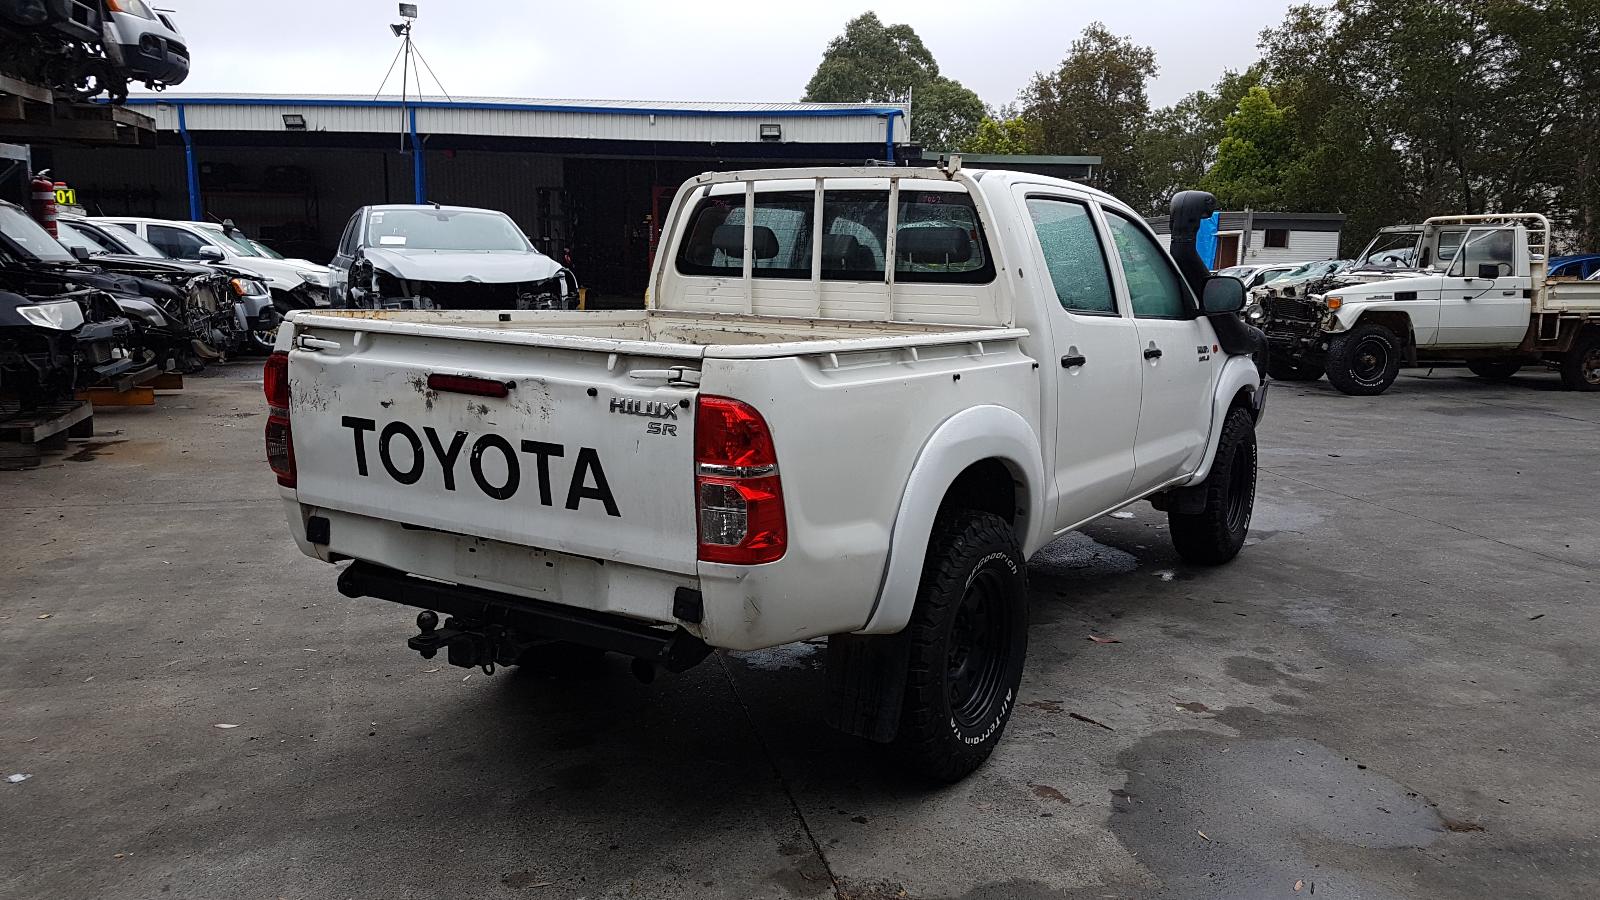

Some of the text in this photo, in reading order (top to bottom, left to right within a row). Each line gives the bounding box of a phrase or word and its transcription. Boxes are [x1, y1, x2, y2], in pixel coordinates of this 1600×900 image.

[609, 397, 678, 420] HILUX
[646, 421, 677, 436] SR
[341, 415, 621, 518] TOYOTA
